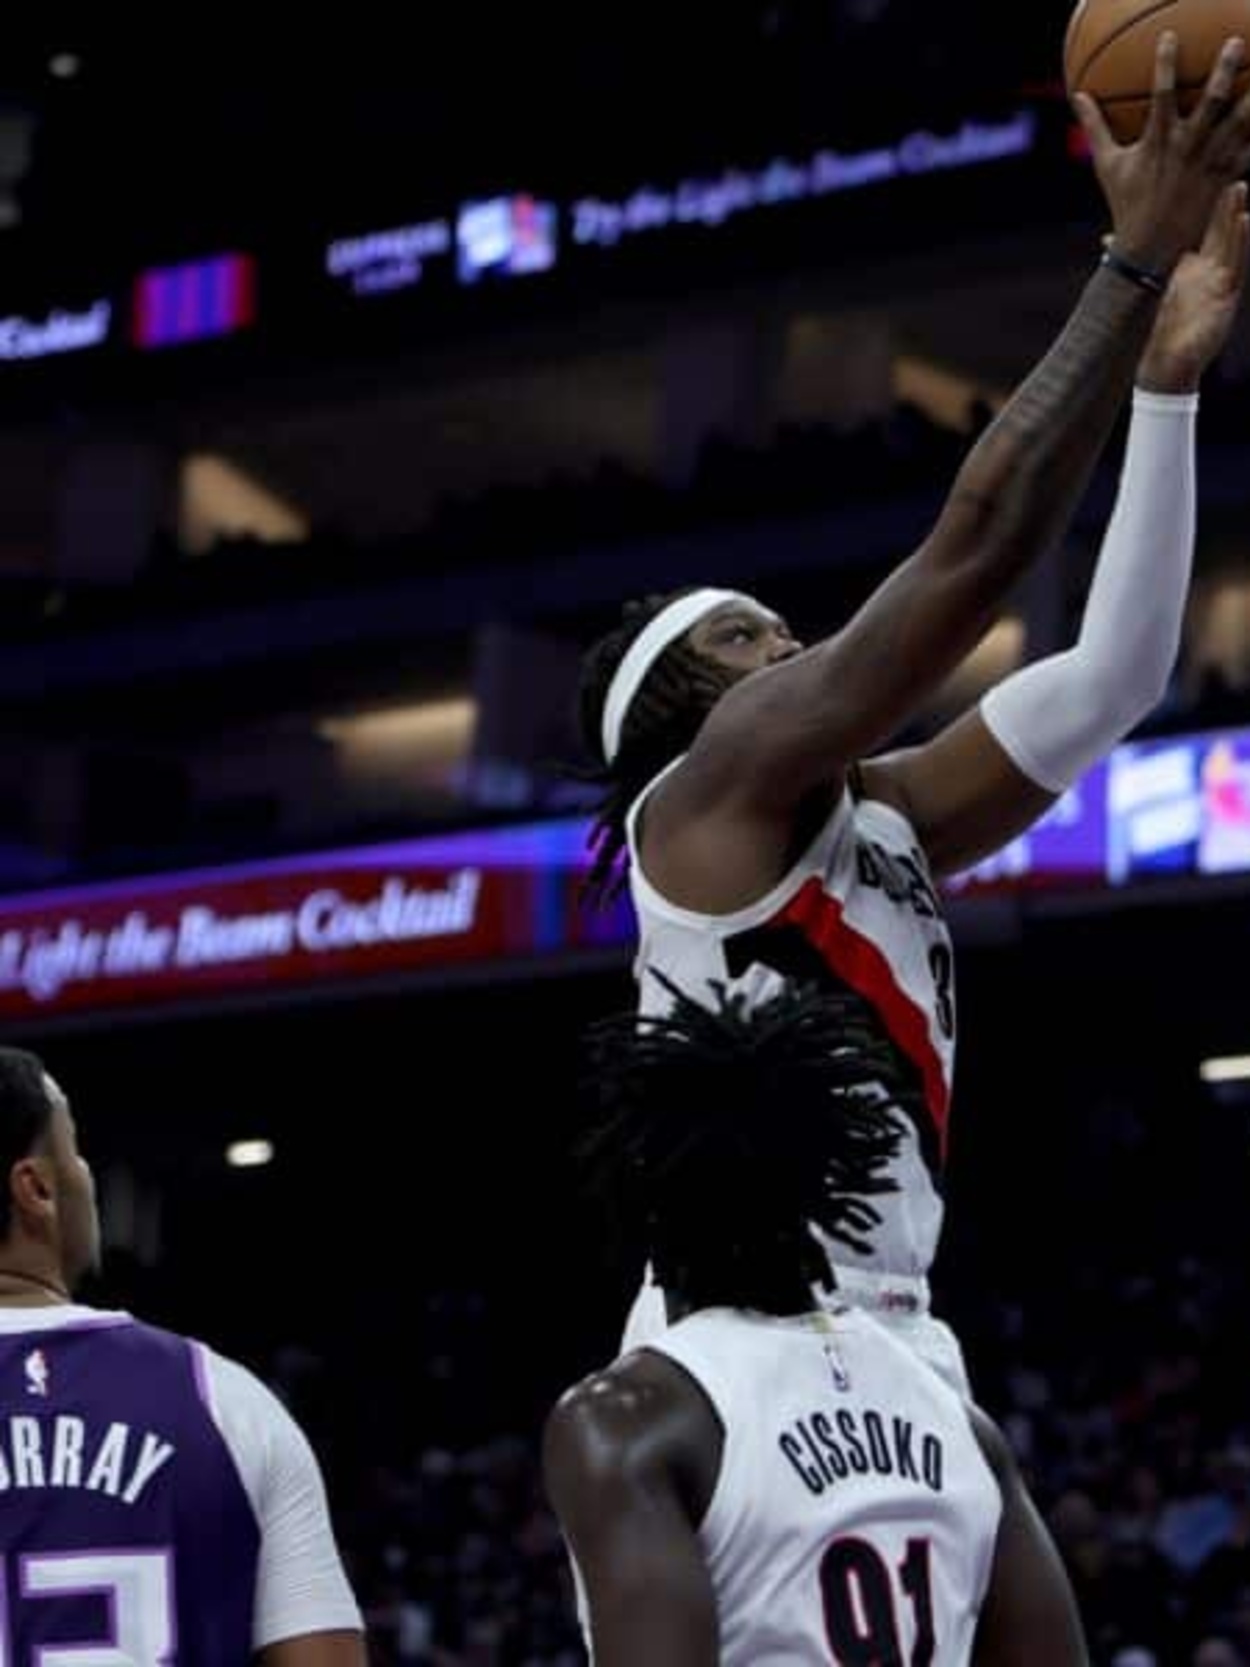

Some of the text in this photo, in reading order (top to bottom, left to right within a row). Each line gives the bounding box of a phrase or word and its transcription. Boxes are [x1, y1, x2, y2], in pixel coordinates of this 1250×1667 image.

[103, 911, 174, 976] the
[175, 905, 295, 968] Beam
[299, 867, 480, 952] Cocktail
[779, 1410, 942, 1496] CISSOKO
[818, 1535, 937, 1667] 91
